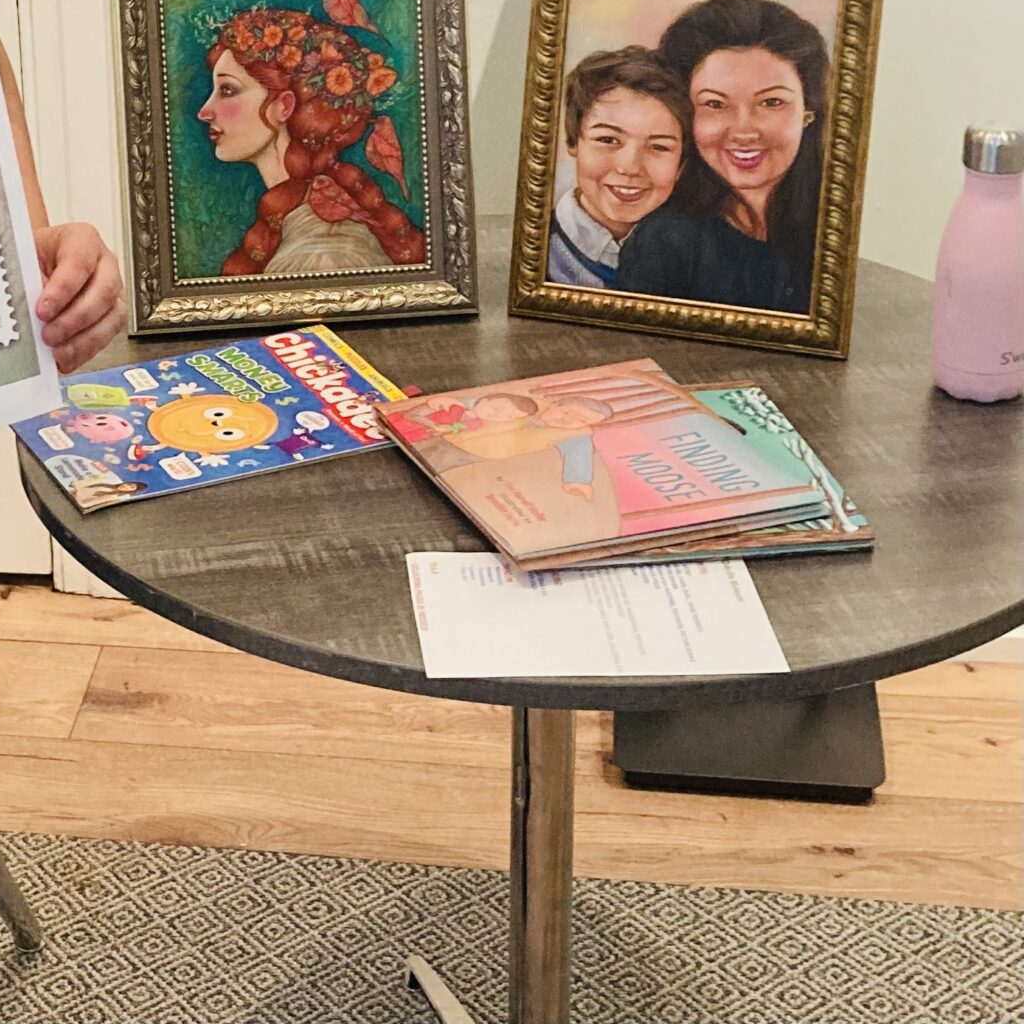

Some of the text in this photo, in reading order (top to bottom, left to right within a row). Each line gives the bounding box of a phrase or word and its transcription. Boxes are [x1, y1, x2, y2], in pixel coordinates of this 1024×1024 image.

[185, 354, 265, 403] SMARTS
[215, 346, 291, 393] MONEY
[616, 452, 707, 502] MOOSE
[659, 431, 760, 492] FINDING
